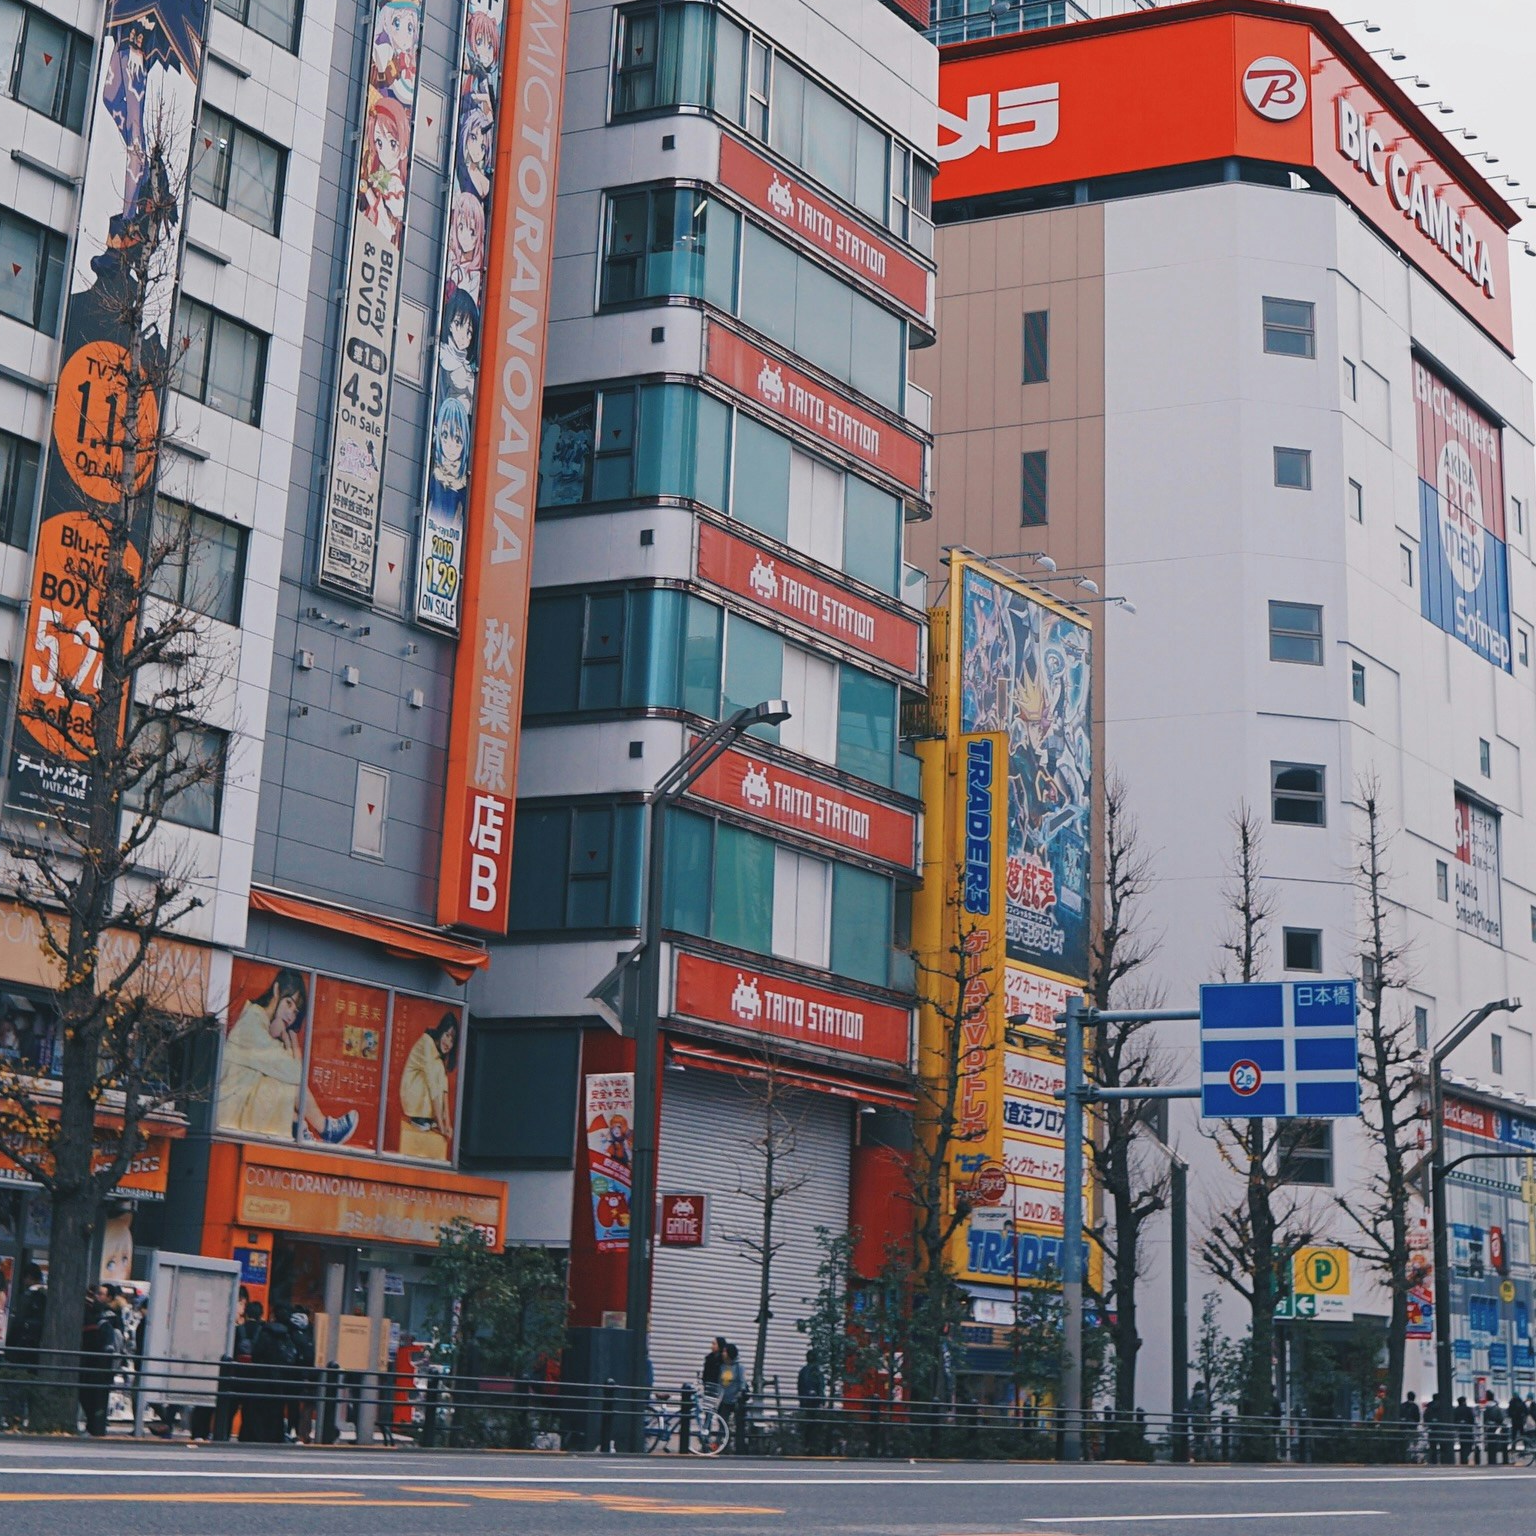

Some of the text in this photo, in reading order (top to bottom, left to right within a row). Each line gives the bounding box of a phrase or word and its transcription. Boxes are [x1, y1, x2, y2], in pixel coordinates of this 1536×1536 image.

[1336, 94, 1497, 300] BIC CAMERA
[797, 196, 886, 279] TAITO STATION
[357, 241, 377, 328] & DVD
[371, 249, 395, 339] Blu-ray
[351, 342, 384, 373] 第1巻
[342, 373, 384, 418] 4.3
[1413, 364, 1498, 464] BicCamera
[341, 408, 382, 438] On Sale
[788, 381, 880, 457] TAITO STATION
[335, 478, 375, 505] TVアニメ
[1442, 446, 1477, 493] AKIBA
[1444, 472, 1478, 537] BIC
[353, 528, 373, 547] 1.30
[431, 534, 454, 564] 2019
[1442, 522, 1483, 587] map
[426, 556, 458, 602] 1.29
[422, 594, 456, 621] ON SALE
[781, 573, 876, 643] TAITO STATION
[1455, 595, 1511, 669] Sofmap
[774, 779, 870, 840] TAITO STATION
[1454, 873, 1478, 902] Audio
[1455, 898, 1500, 938] SmartPhone
[765, 991, 864, 1042] TAITO STATION
[1296, 986, 1351, 1007] 日本橋
[666, 1217, 699, 1235] GAME
[1314, 1258, 1332, 1284] P
